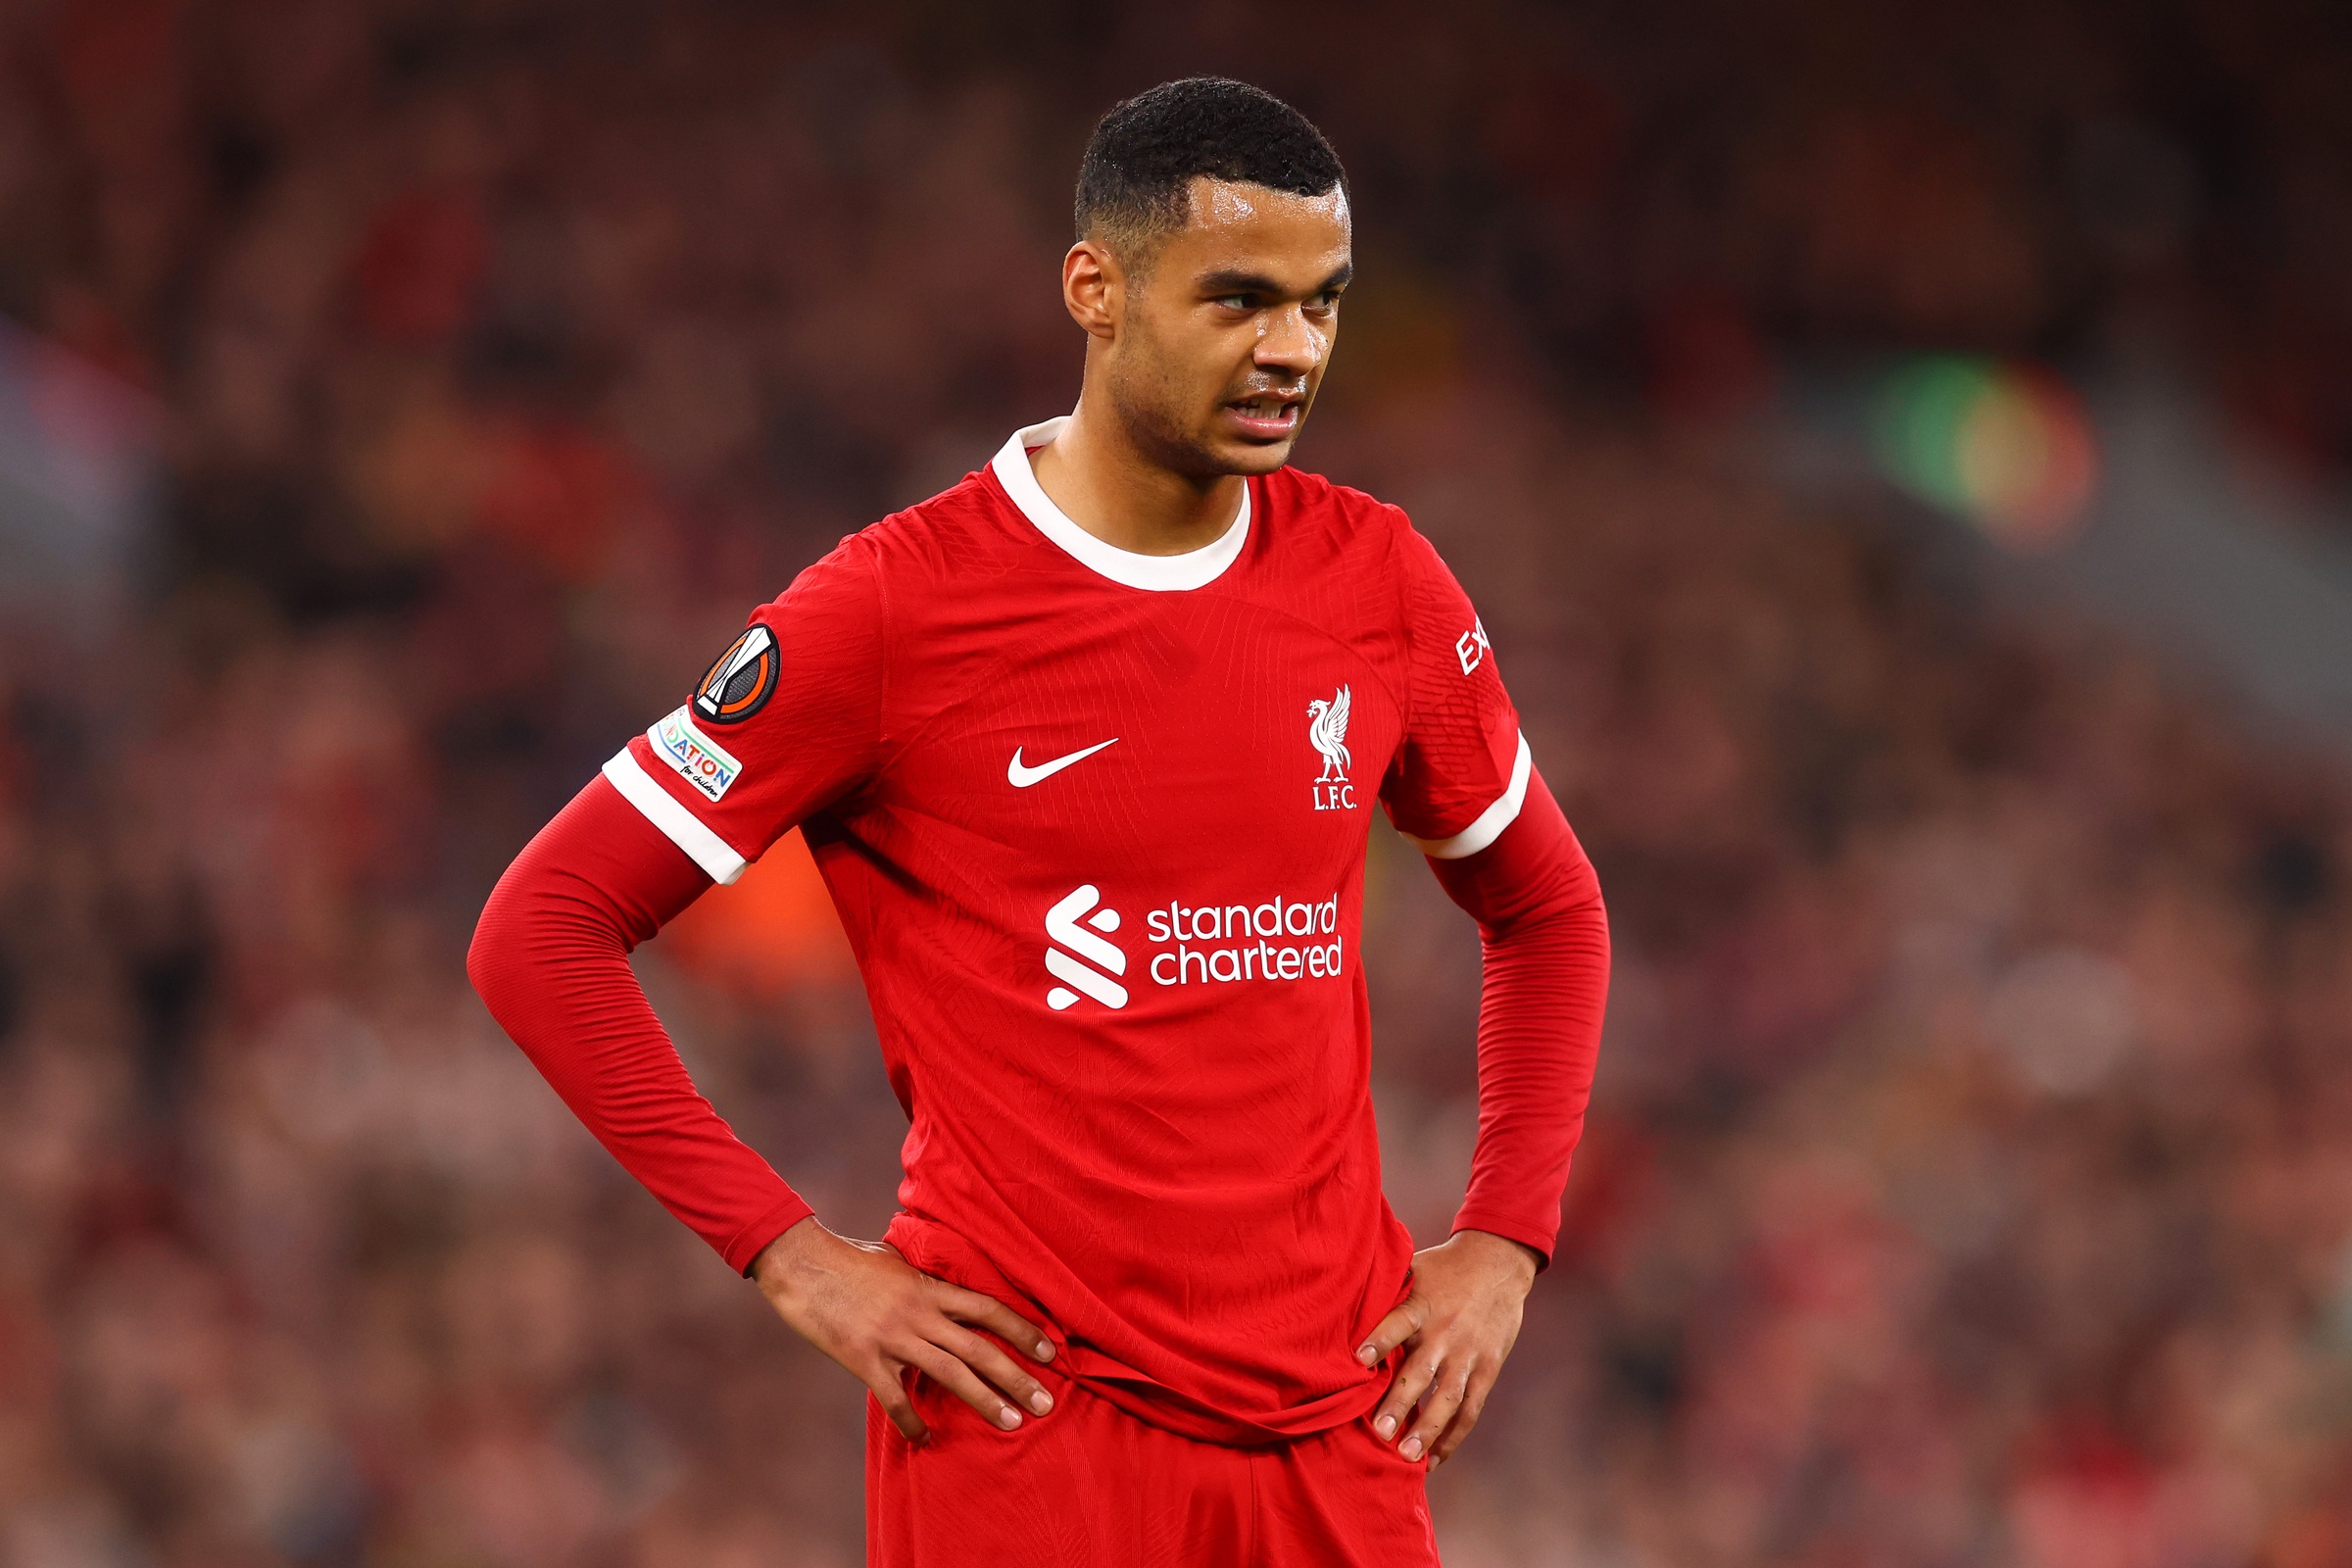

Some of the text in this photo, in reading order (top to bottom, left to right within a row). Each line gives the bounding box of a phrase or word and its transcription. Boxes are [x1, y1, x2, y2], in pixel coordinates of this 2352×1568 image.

[692, 775, 718, 798] children
[1312, 785, 1357, 810] L.F.C.
[1147, 892, 1338, 943] standard
[1150, 935, 1343, 986] chartered
